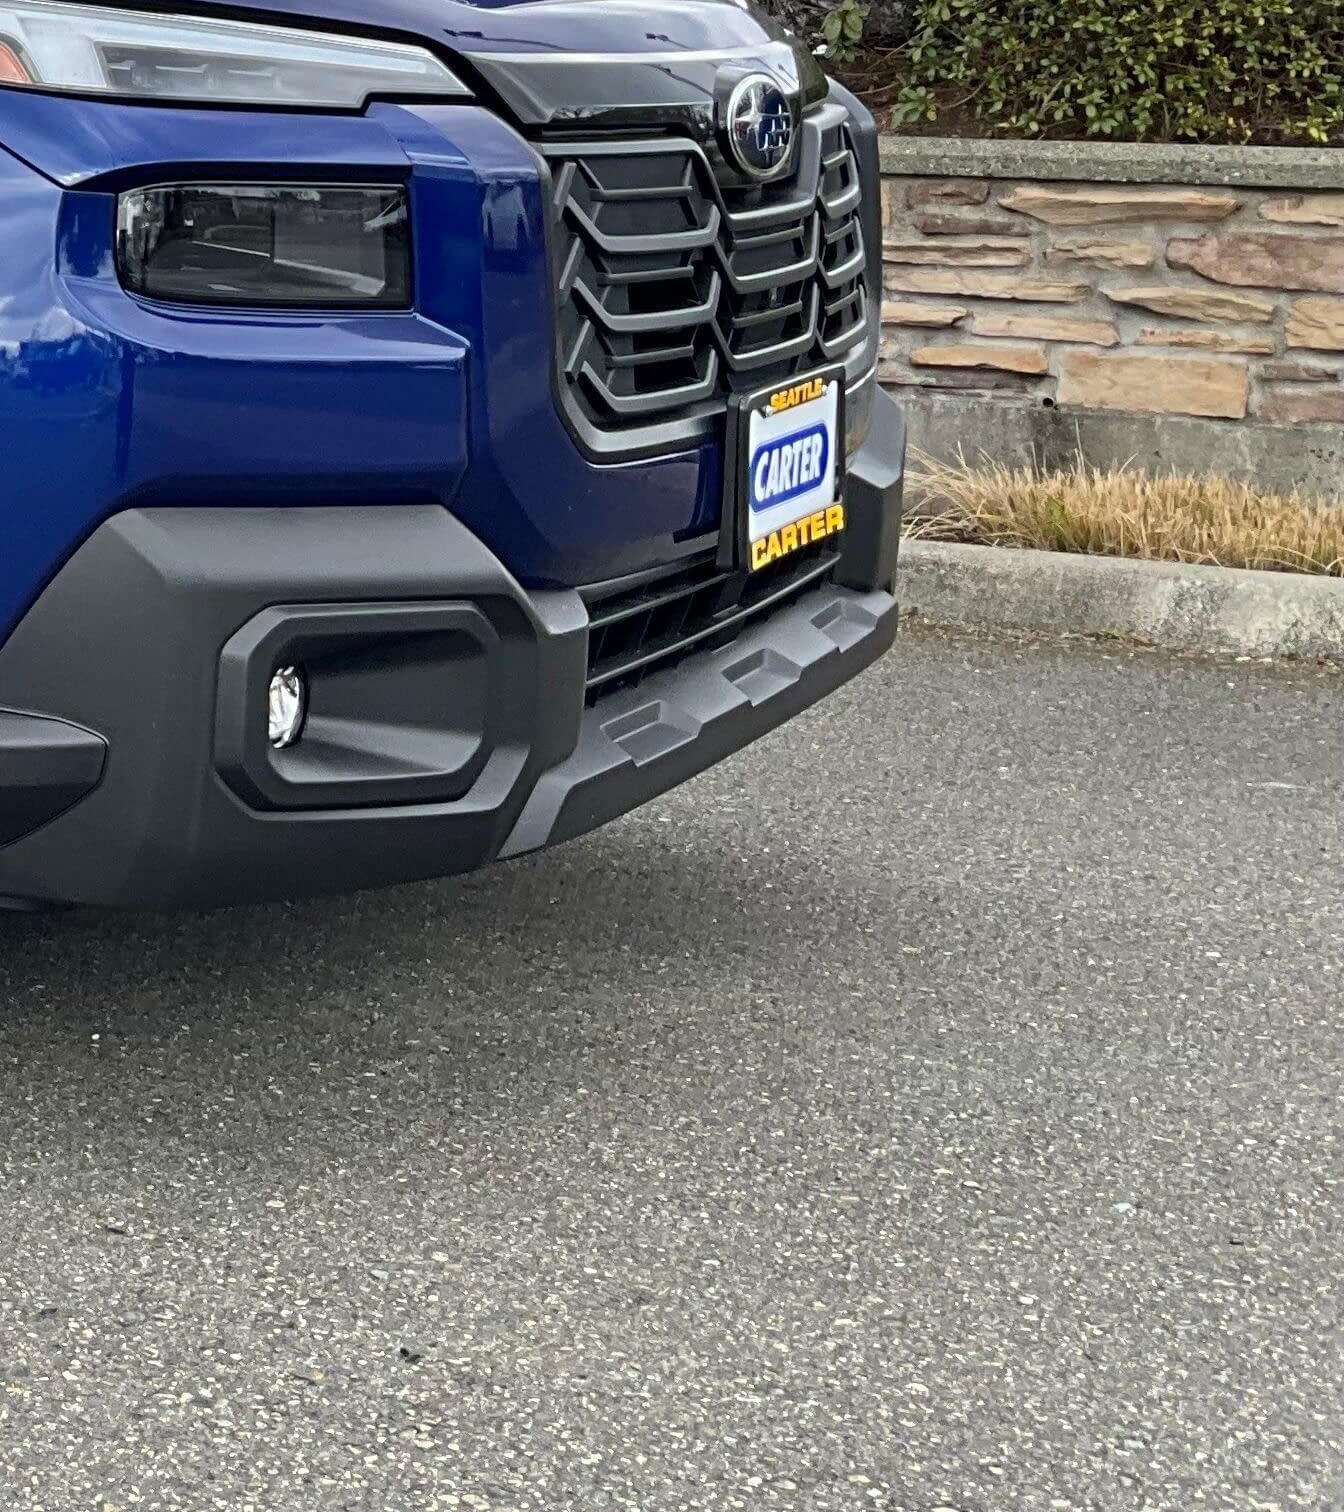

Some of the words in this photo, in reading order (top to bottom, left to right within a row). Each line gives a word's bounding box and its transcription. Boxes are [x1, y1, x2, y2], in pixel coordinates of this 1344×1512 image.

[770, 378, 824, 414] SEATTLE
[753, 432, 822, 502] CARTER
[751, 505, 845, 571] CARTER
